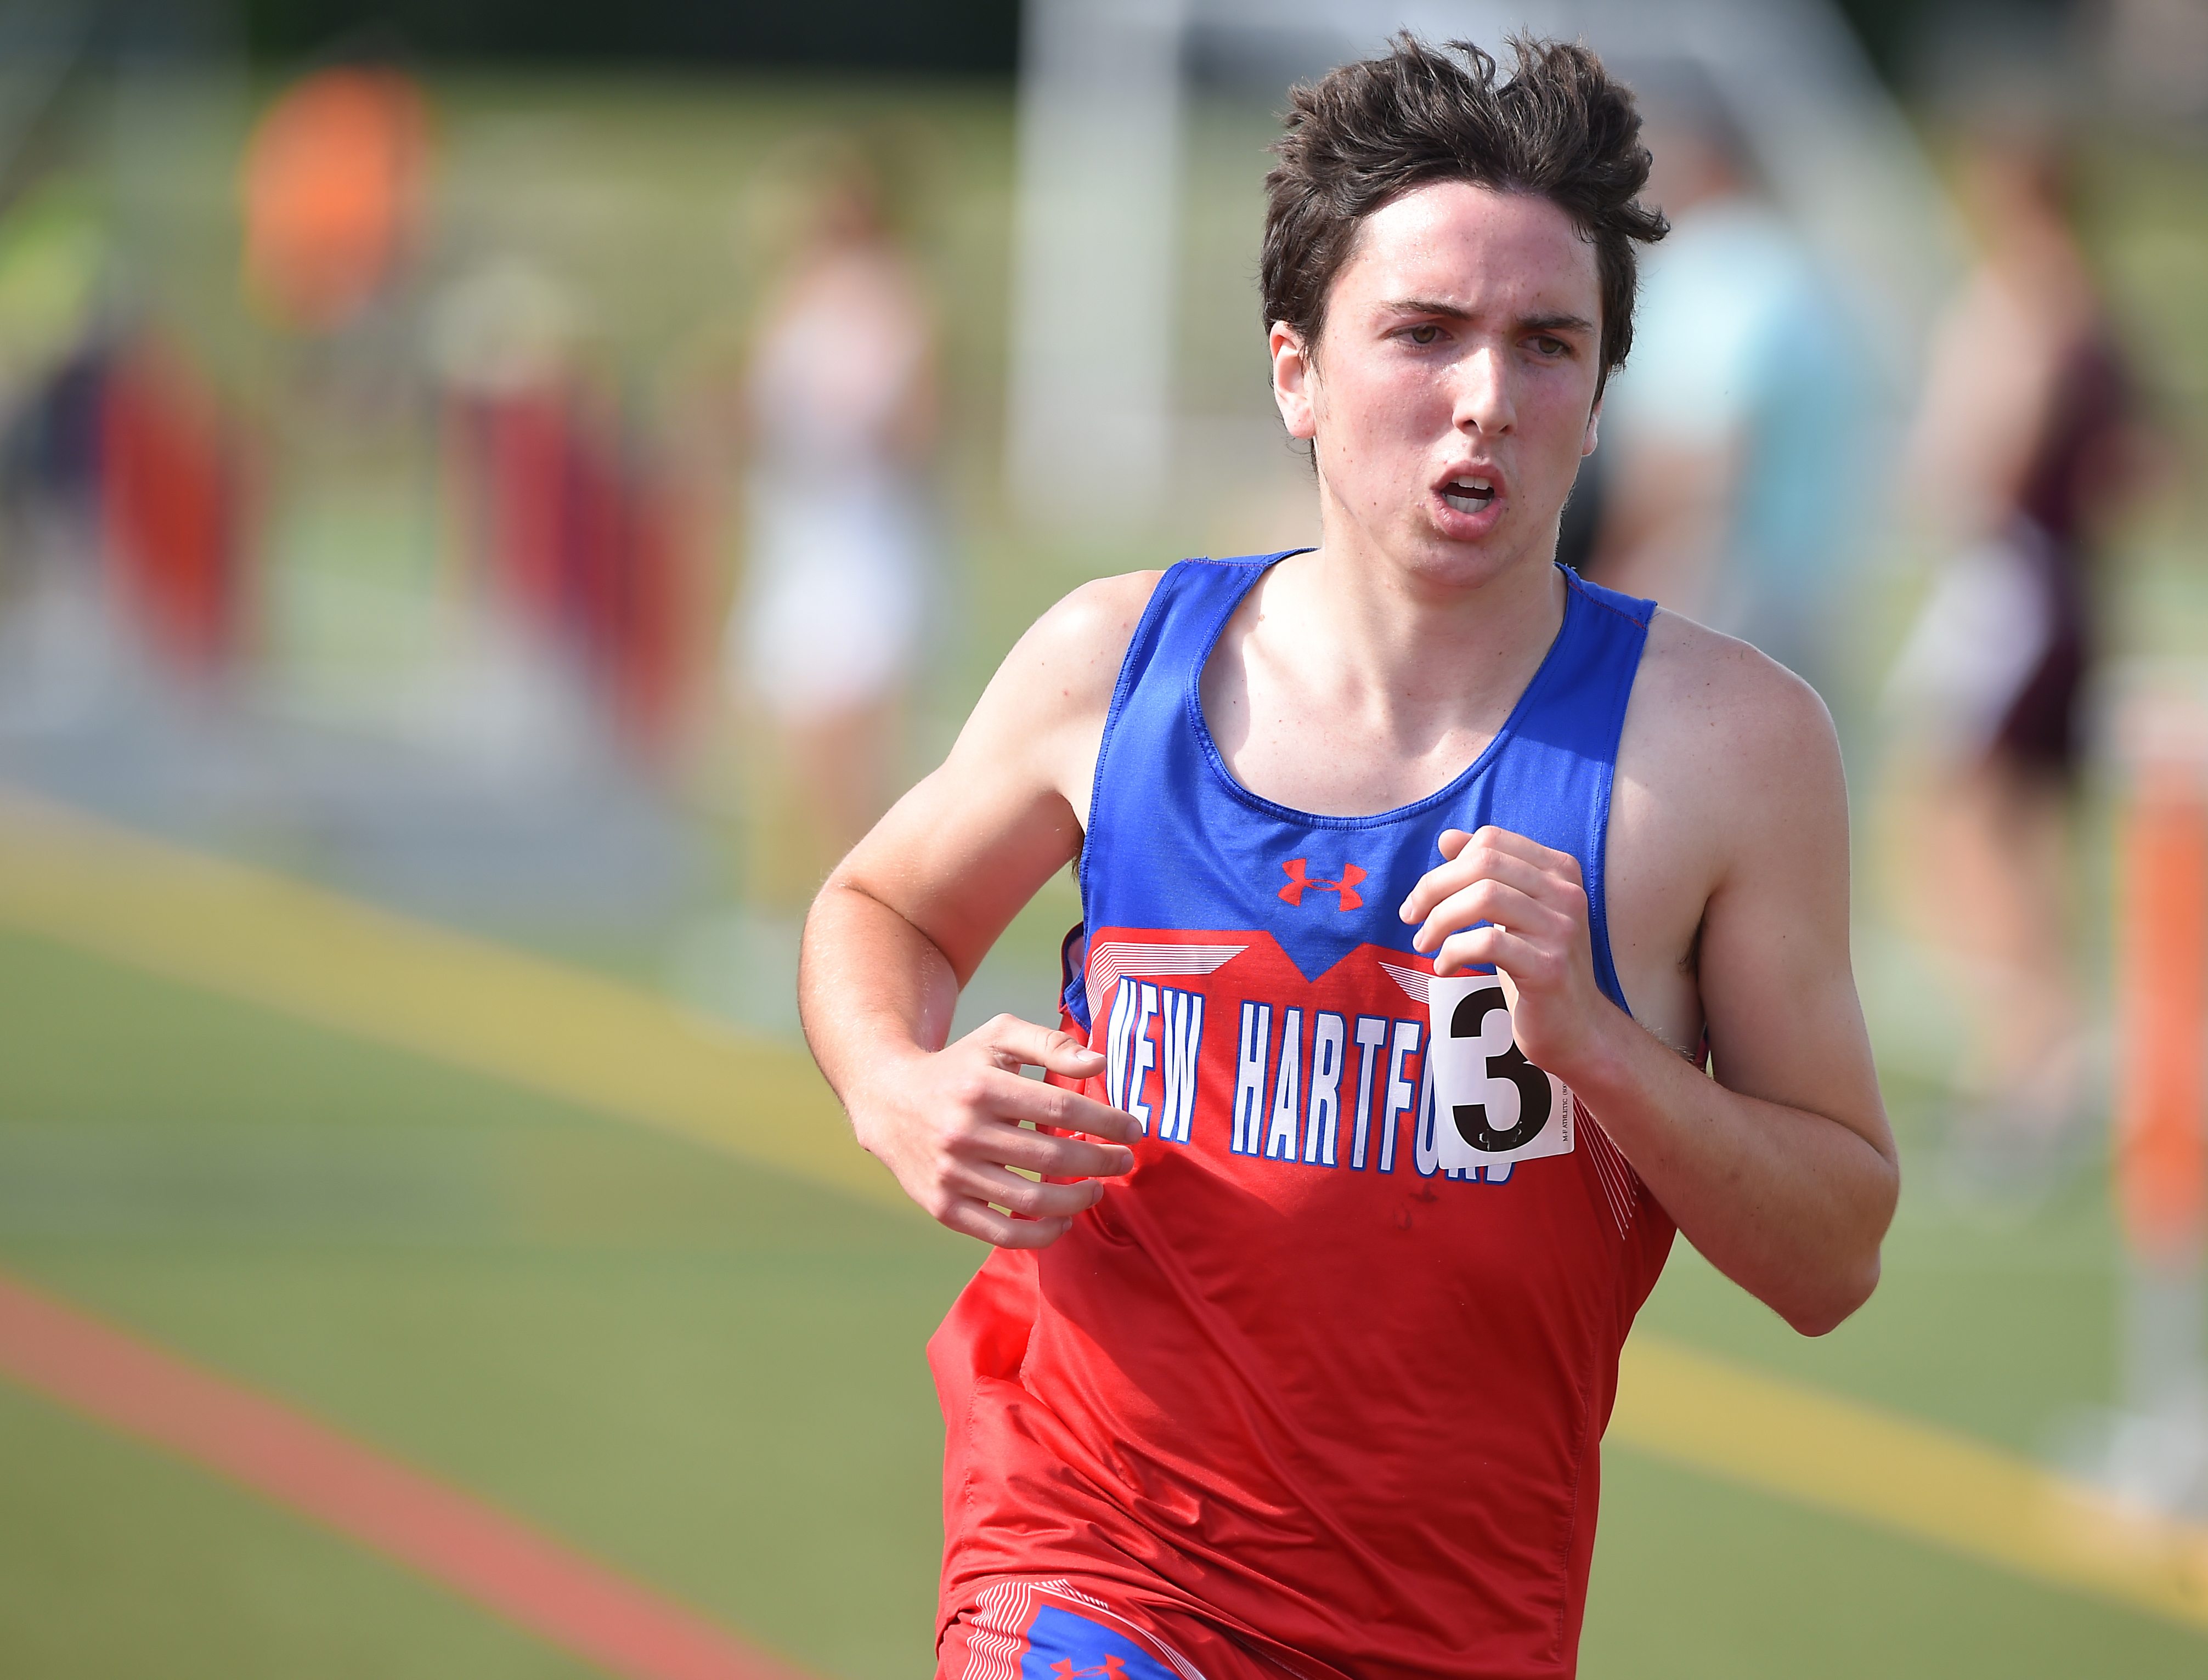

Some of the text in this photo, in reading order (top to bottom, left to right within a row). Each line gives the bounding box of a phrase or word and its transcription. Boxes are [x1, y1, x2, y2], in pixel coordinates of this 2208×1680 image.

[1106, 975, 1516, 1185] NEW HARTFO
[1450, 987, 1552, 1152] 3
